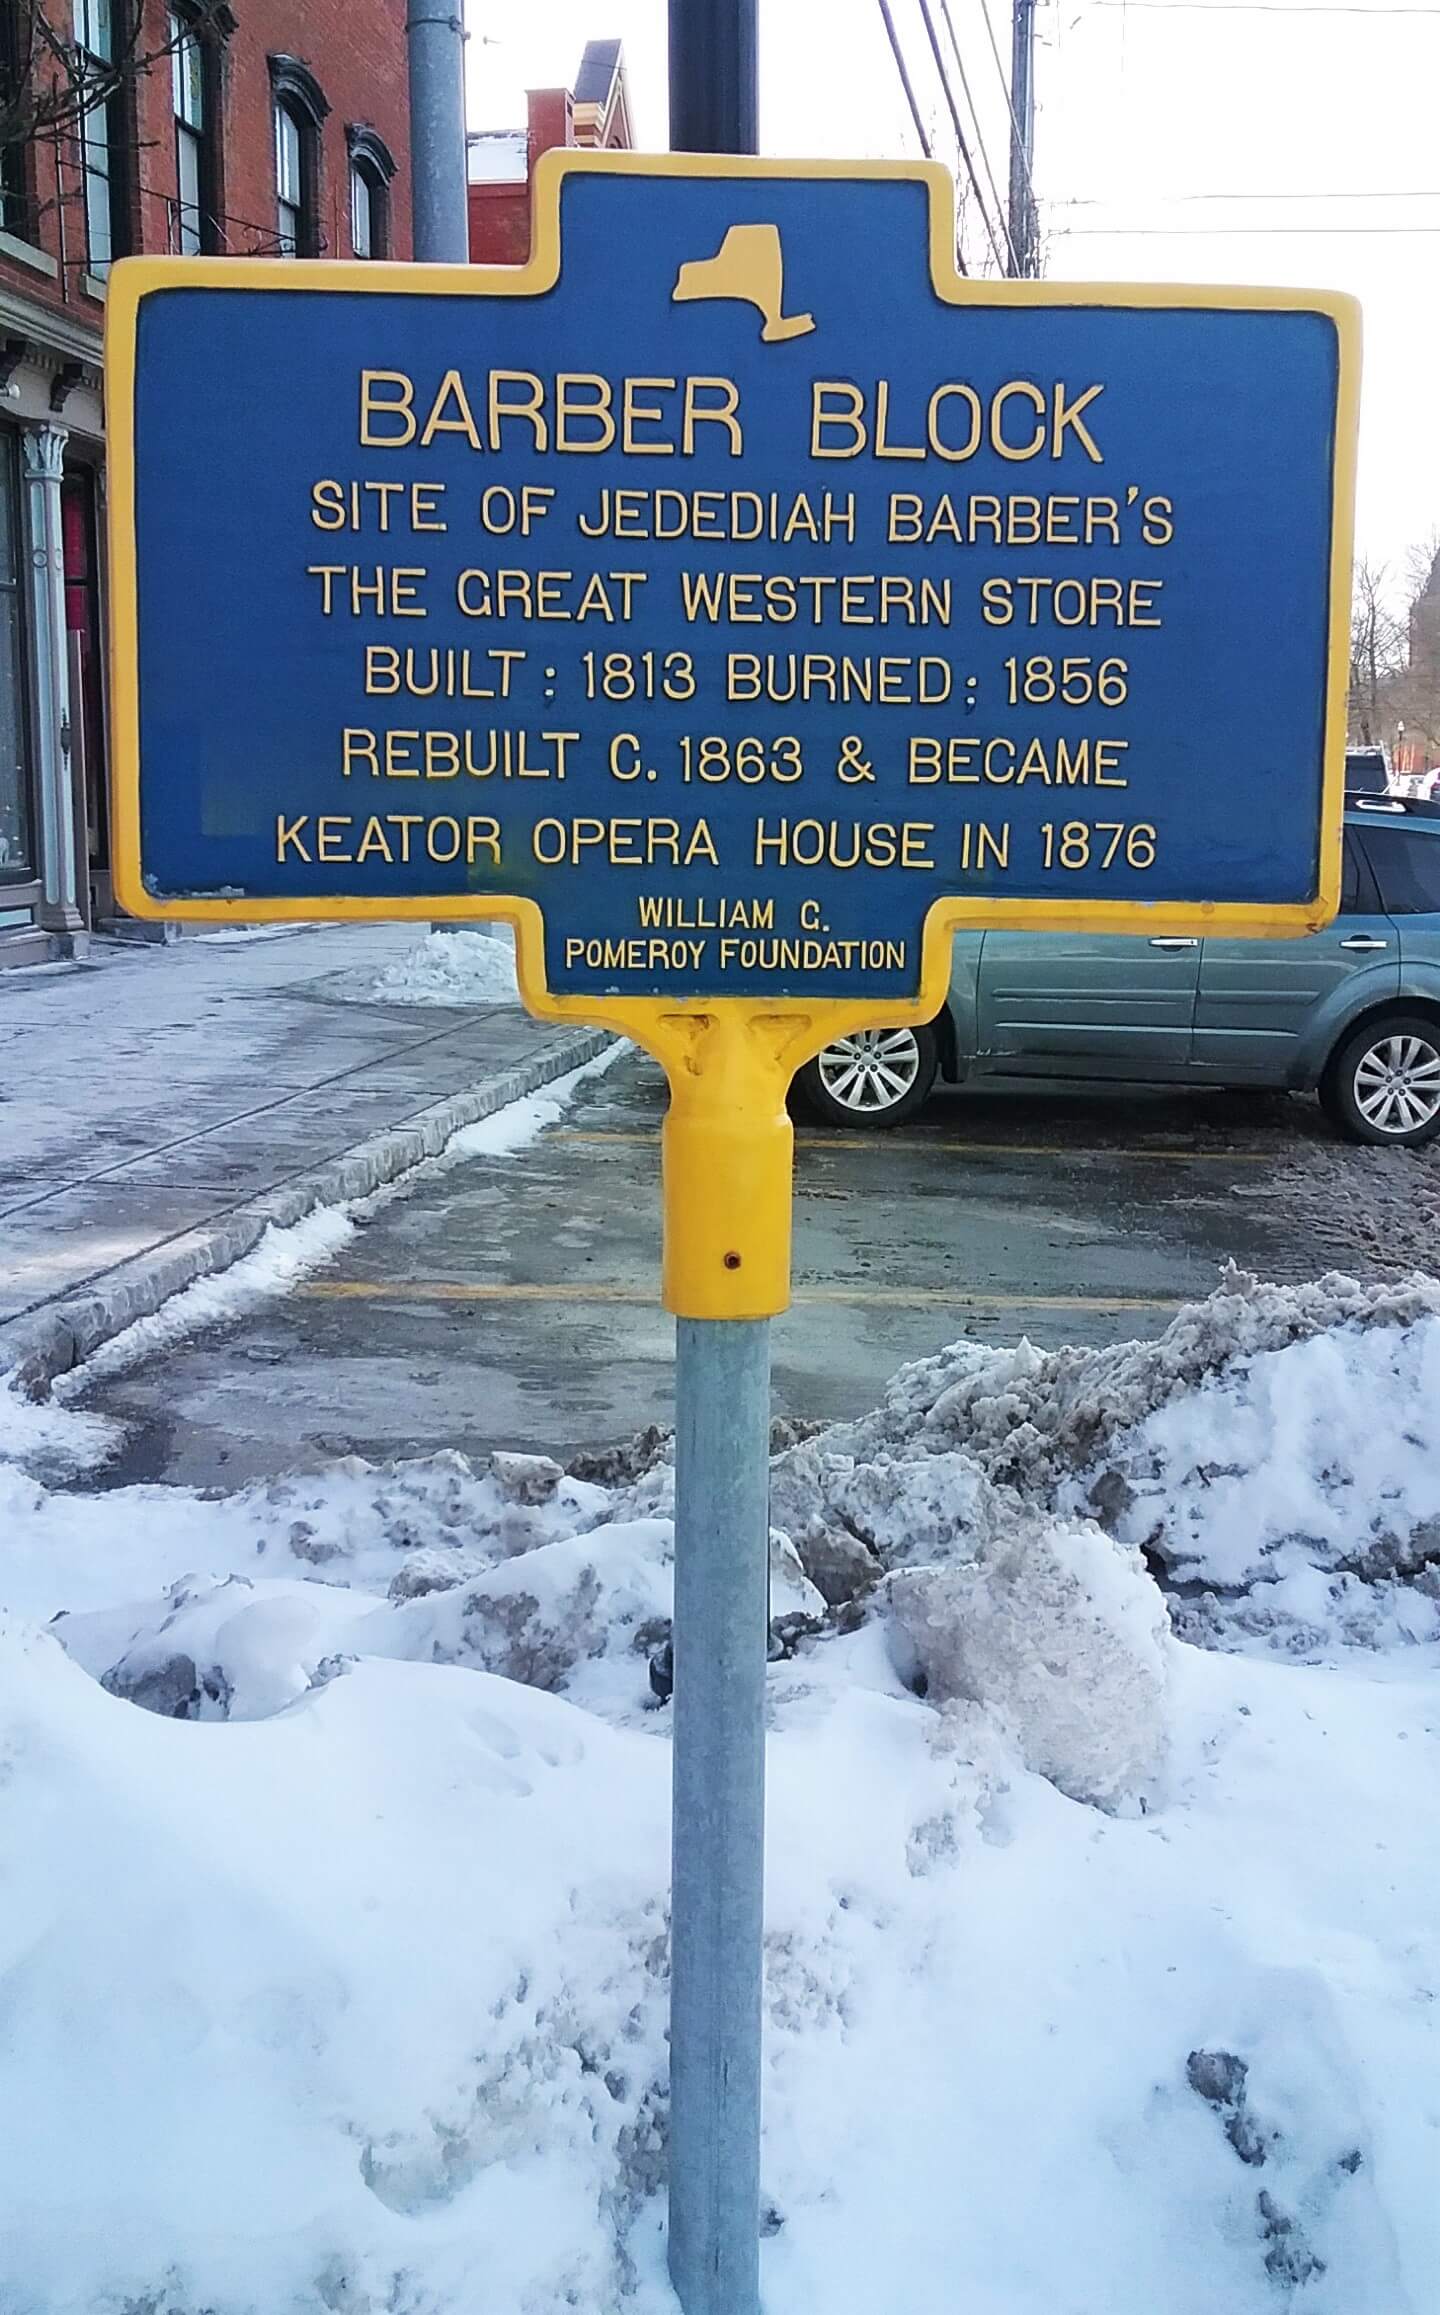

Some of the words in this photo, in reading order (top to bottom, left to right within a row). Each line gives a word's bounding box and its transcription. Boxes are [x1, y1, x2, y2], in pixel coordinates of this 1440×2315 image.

[361, 371, 742, 456] BARBER
[812, 382, 1101, 463] BLOCK
[312, 481, 445, 533] SITE
[483, 486, 554, 536] OF
[579, 490, 855, 541] JEDEDIAH
[888, 488, 1173, 545] BARBER'S
[309, 567, 425, 616] THE
[457, 570, 646, 620] GREAT
[682, 575, 951, 625] WESTERN
[982, 578, 1159, 627] STORE
[584, 653, 696, 700] 1813
[1005, 658, 1128, 706] 1856
[343, 730, 578, 779] REBUILT
[610, 732, 657, 781] C.
[680, 736, 803, 782] 1863
[837, 737, 874, 783] &
[909, 738, 1126, 787] BECAME
[277, 816, 501, 864] KEATOR
[533, 819, 718, 866] OPERA
[755, 821, 935, 868] HOUSE
[961, 825, 1009, 869] IN
[1041, 822, 1156, 869] 1876
[639, 897, 774, 929] WILLIAM
[800, 899, 831, 932] G.
[566, 939, 705, 969] POMEROY
[720, 939, 905, 969] FOUNDATION
